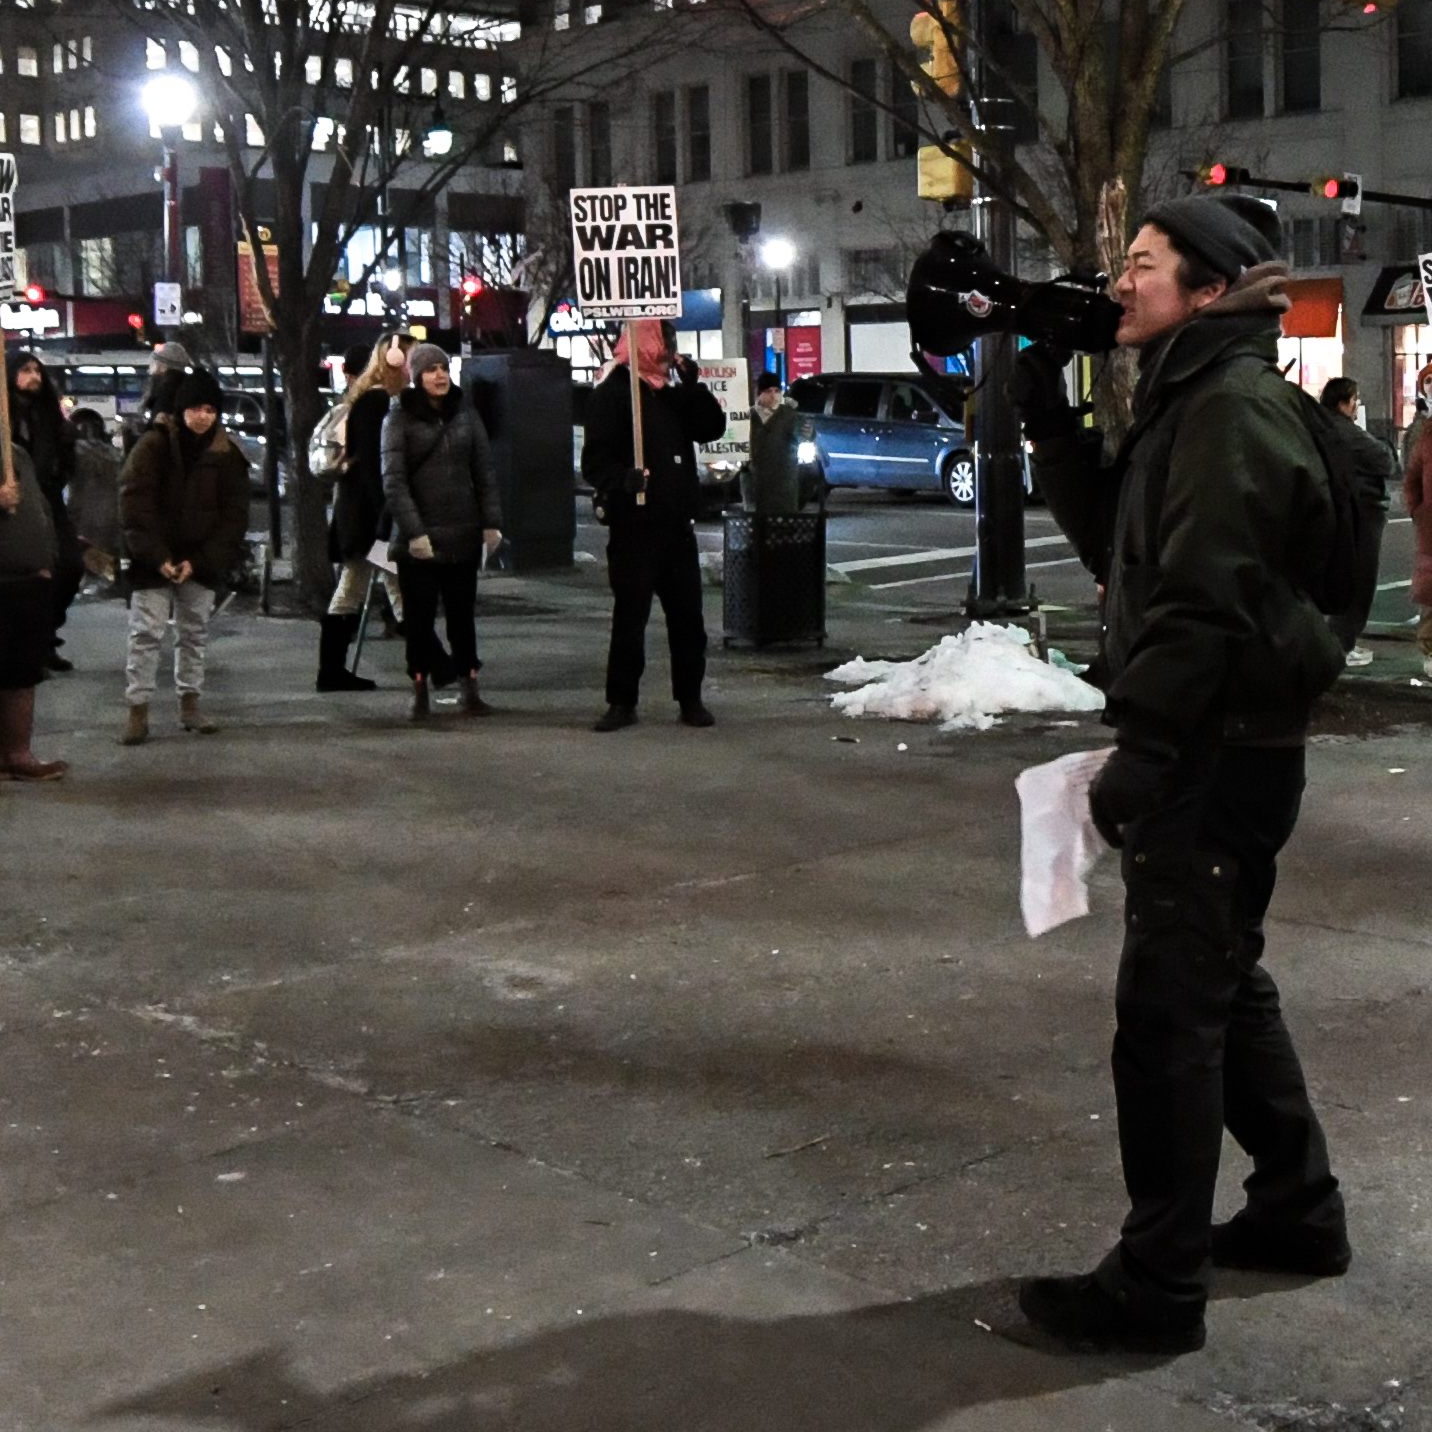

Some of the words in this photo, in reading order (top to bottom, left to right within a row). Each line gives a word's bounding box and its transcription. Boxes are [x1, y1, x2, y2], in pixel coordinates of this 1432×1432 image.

[574, 194, 627, 222] STOP
[632, 193, 672, 221] THE
[575, 224, 674, 251] WAR
[579, 257, 612, 301] ON
[617, 256, 678, 300] IRAN!
[582, 306, 677, 317] PSLWEB.ORG
